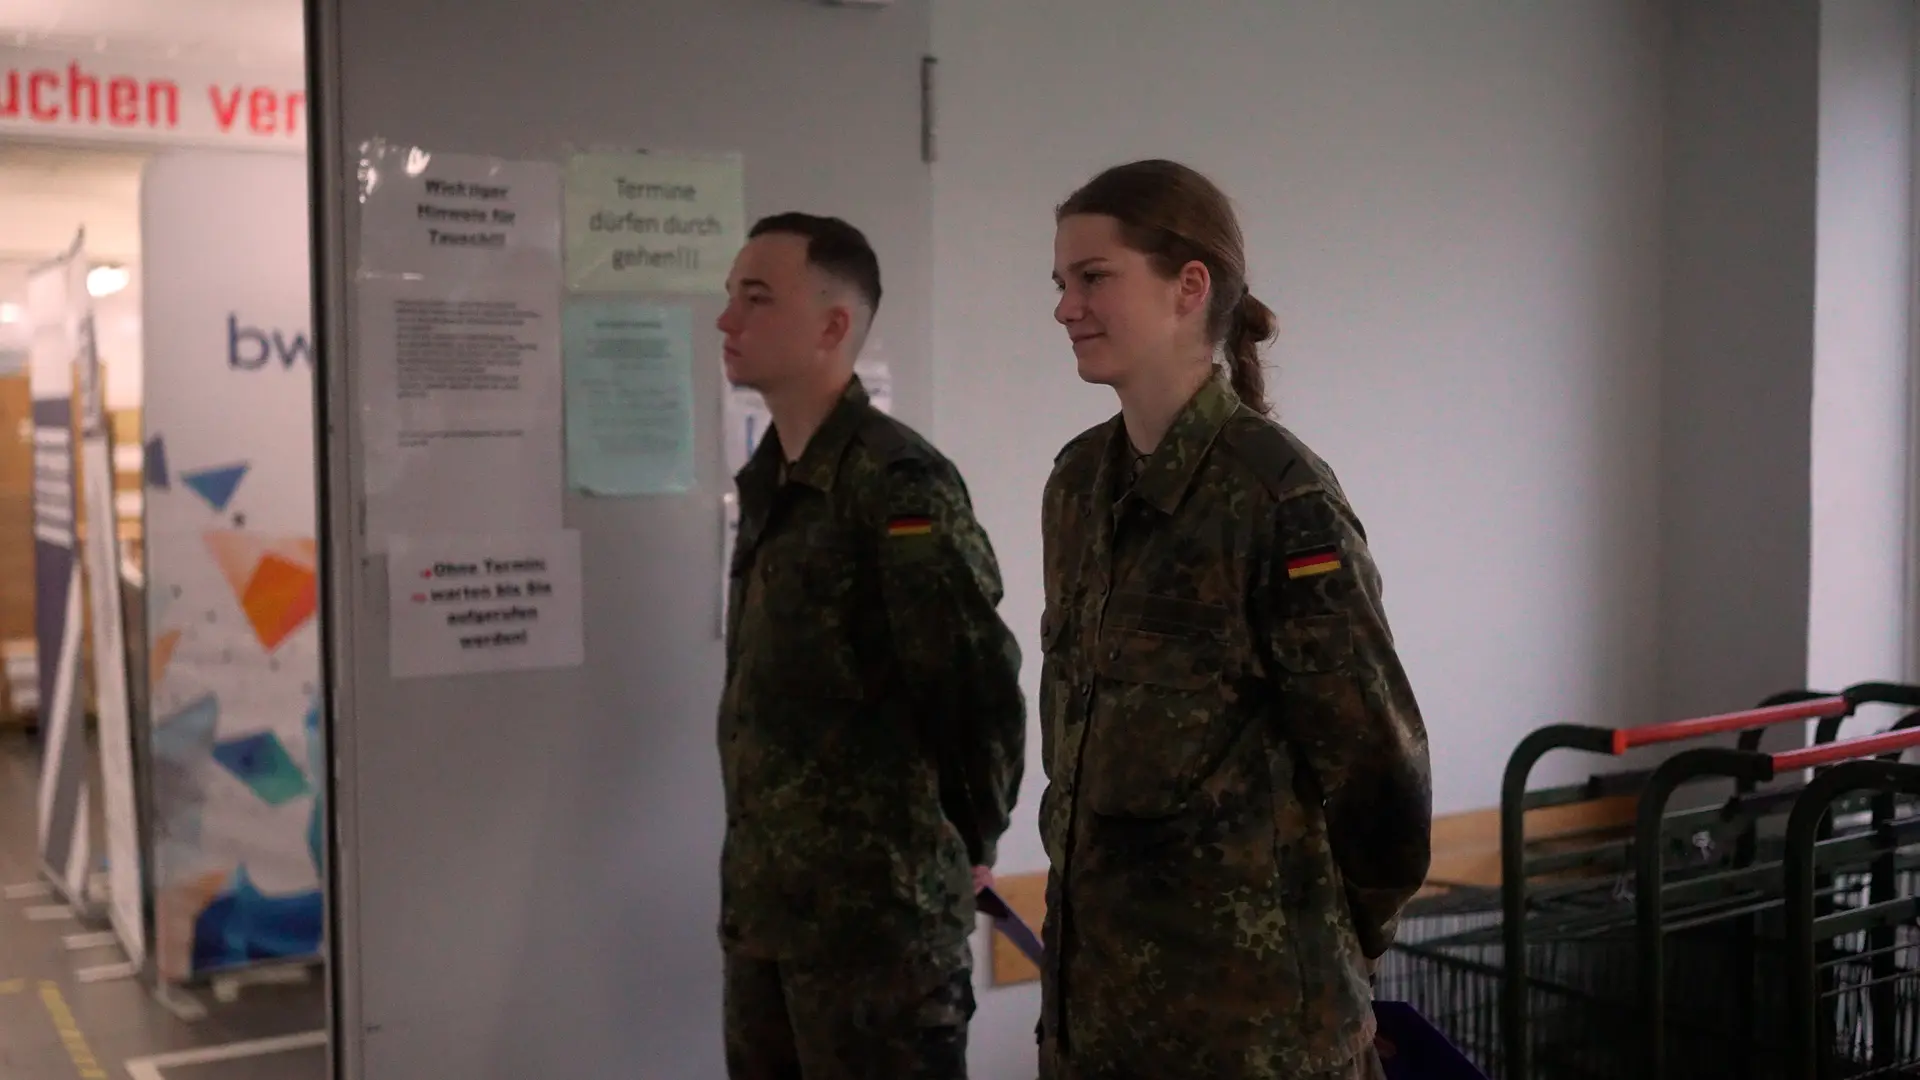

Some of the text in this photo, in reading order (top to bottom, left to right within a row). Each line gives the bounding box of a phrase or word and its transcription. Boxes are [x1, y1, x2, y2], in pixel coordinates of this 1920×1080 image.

[614, 176, 697, 201] Termine
[589, 209, 722, 236] dürfen durch
[433, 560, 477, 578] Ohne
